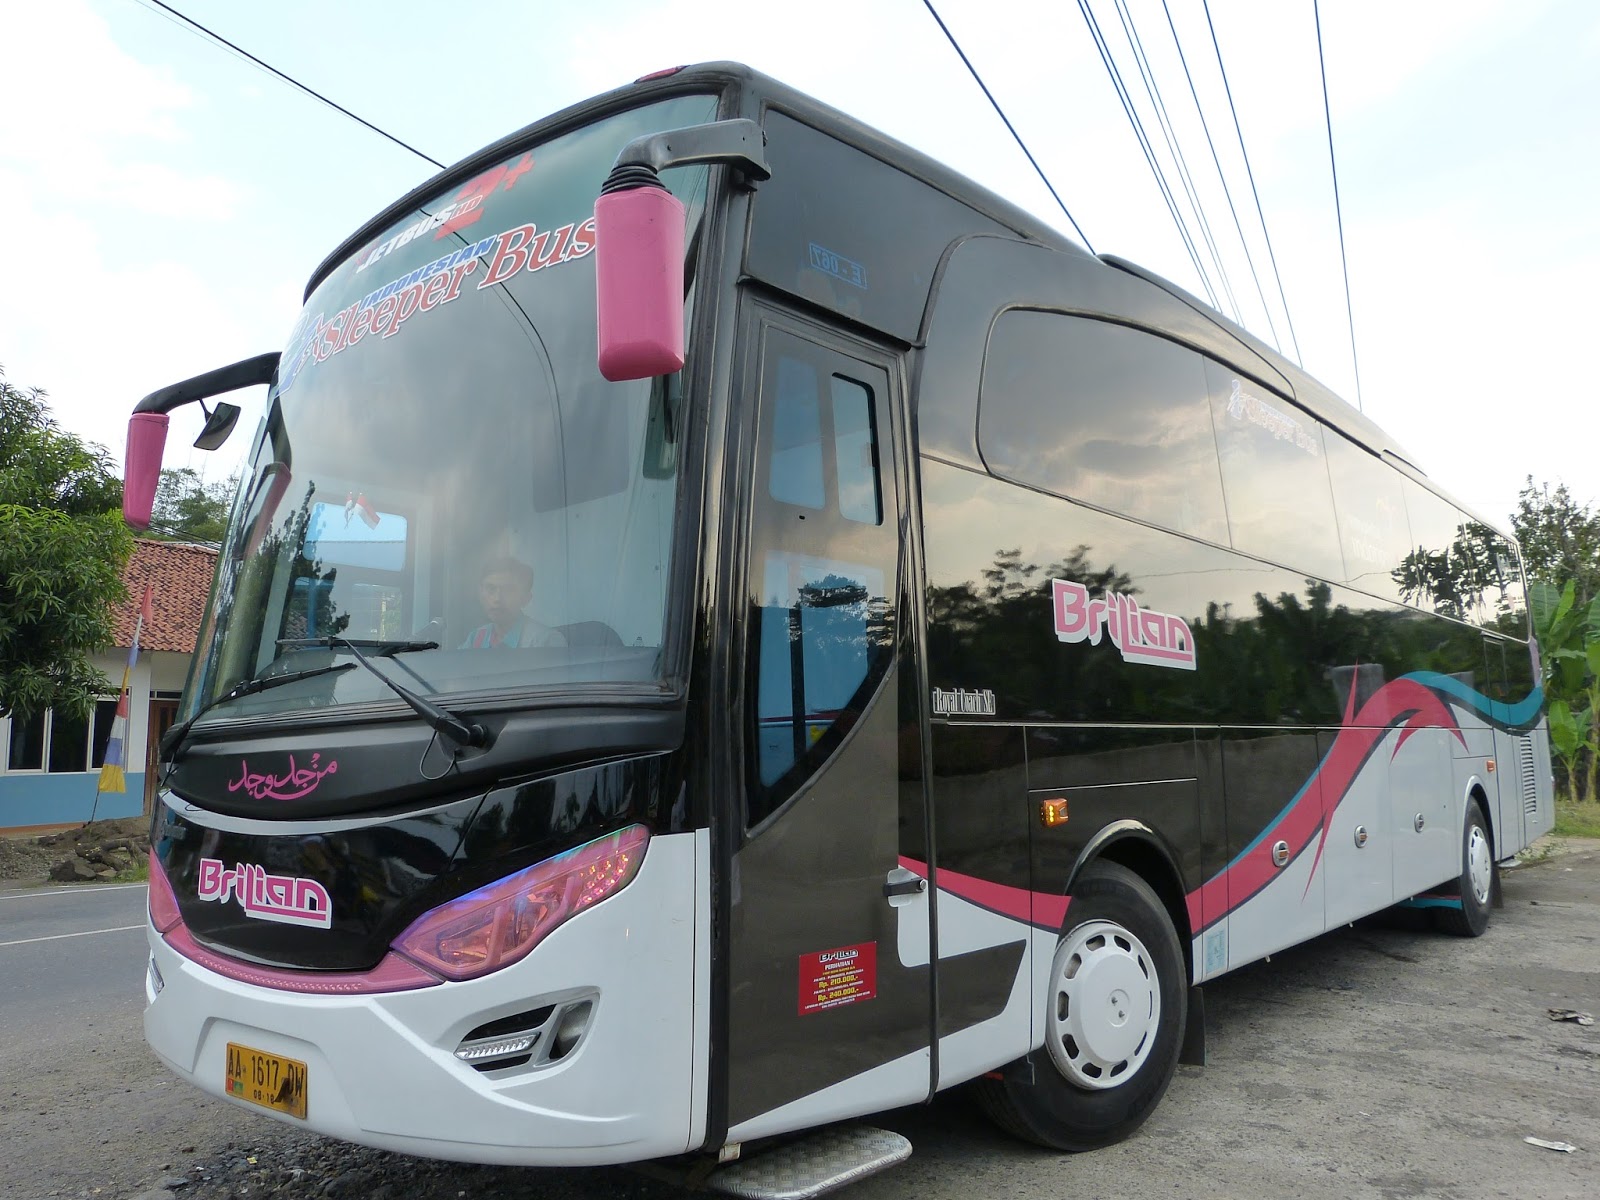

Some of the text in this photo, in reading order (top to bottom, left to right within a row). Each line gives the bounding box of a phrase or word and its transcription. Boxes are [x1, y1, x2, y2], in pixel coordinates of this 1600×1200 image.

[356, 203, 456, 273] JETBUS
[359, 235, 498, 311] INDONESIAN
[313, 258, 479, 366] Sleeper
[477, 215, 597, 291] Bus
[1052, 578, 1196, 670] Brilian
[934, 687, 958, 717] Royal
[960, 688, 981, 713] Coach
[198, 858, 332, 929] Brilian
[228, 1048, 241, 1078] AA
[252, 1055, 279, 1090] 1617
